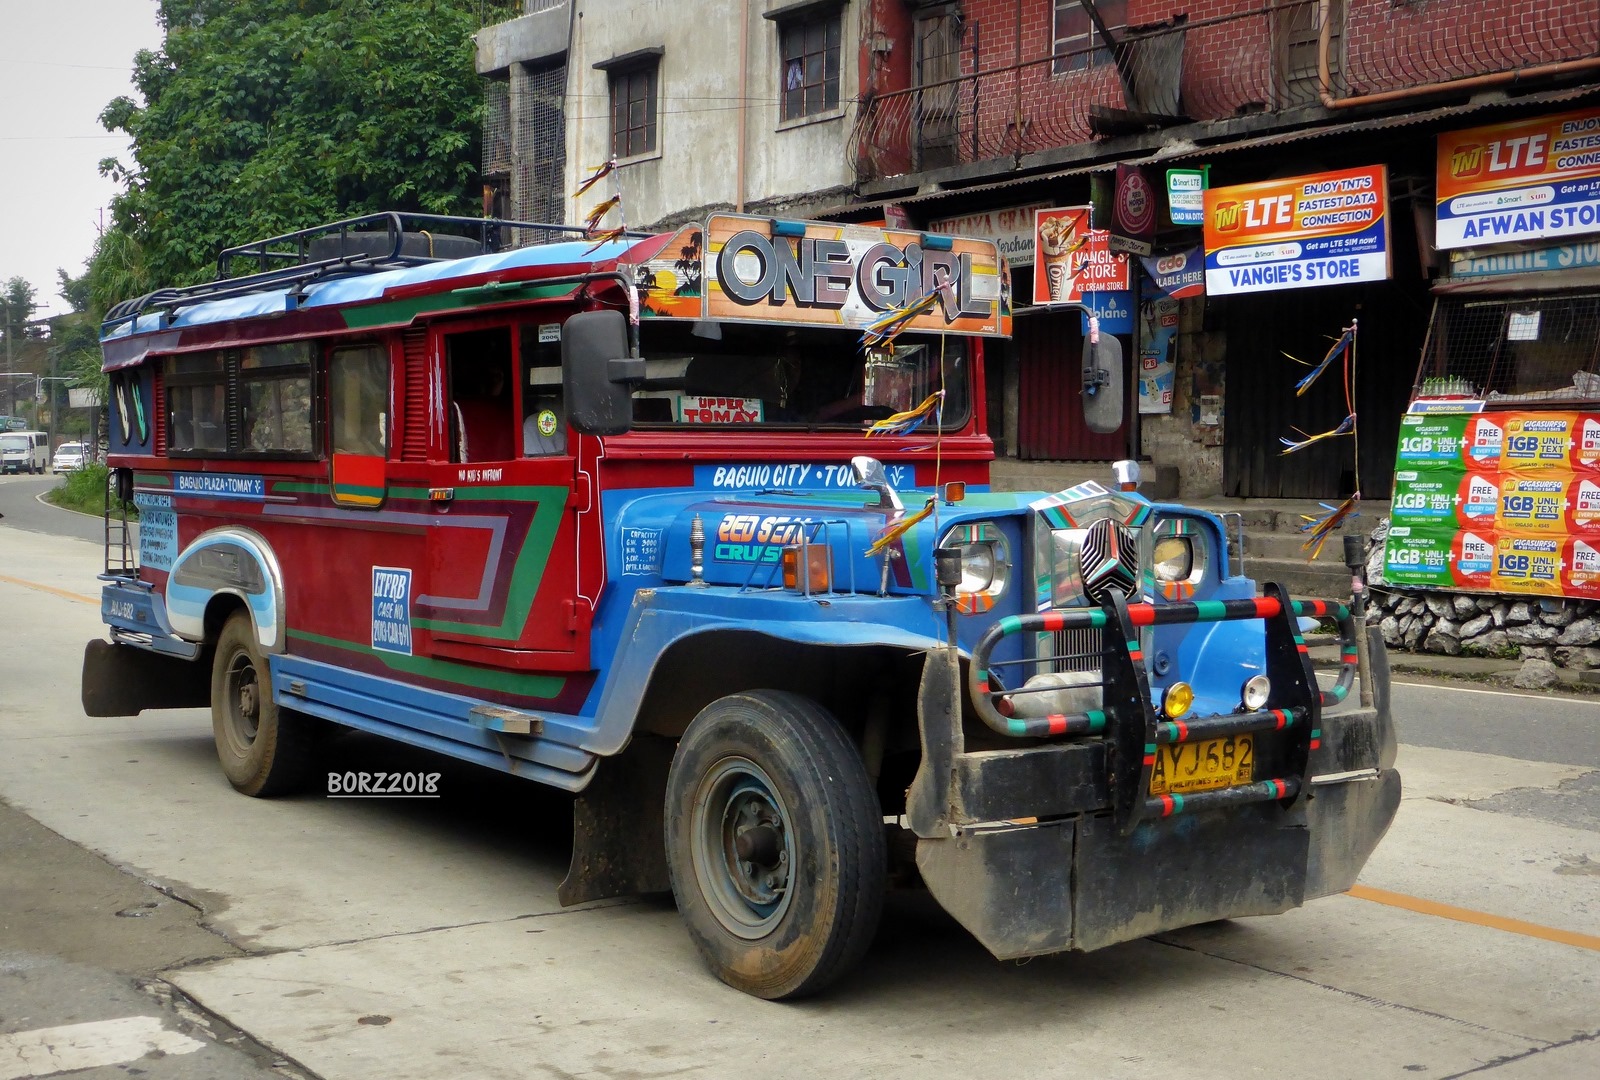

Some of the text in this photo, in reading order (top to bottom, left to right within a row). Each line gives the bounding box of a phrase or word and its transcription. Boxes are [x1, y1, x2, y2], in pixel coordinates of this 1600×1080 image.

[1562, 117, 1600, 133] ENJO
[1553, 136, 1600, 152] FASTES
[1488, 134, 1547, 172] LTE
[1452, 146, 1483, 175] TNT
[1190, 178, 1200, 186] LTE
[1304, 177, 1371, 195] ENJOY TNT'S
[1561, 185, 1576, 194] Get
[1128, 198, 1144, 206] HORSE
[1298, 193, 1376, 211] FASTEST DATA
[1504, 196, 1522, 204] Smart
[1171, 212, 1184, 220] LOAD
[1216, 202, 1241, 230] TNT
[1243, 195, 1293, 228] LTE
[1302, 209, 1371, 227] CONNECTION
[1463, 211, 1544, 239] AFWAN
[1330, 240, 1343, 248] LTE
[1344, 238, 1358, 246] SIM
[1359, 236, 1377, 244] now!
[1159, 256, 1184, 271] cdo
[1454, 243, 1600, 273] ANNIE STO
[719, 230, 854, 306] ONE
[1083, 263, 1117, 279] STORE
[1230, 259, 1360, 287] VANGIE'S STORE
[1182, 271, 1202, 283] HERE
[1076, 281, 1124, 292] ICE CREAM STORE
[1087, 306, 1127, 319] olane
[698, 397, 744, 412] UPPER
[684, 409, 758, 423] TOMAY
[1478, 428, 1498, 437] FREE
[1585, 430, 1600, 438] FRE
[1400, 437, 1432, 453] 1GB
[1437, 437, 1457, 445] UNLI
[1508, 436, 1538, 451] 1GB
[1542, 437, 1564, 445] UNLI
[1436, 445, 1457, 453] TEXT
[1541, 445, 1564, 453] TEXT
[713, 466, 770, 489] BAGUIO
[773, 464, 812, 487] CITY
[179, 476, 253, 493] BAGUIO PLAZA TOMAY
[1471, 486, 1492, 495] FREE
[1395, 493, 1426, 509] 1GB
[1431, 494, 1450, 502] UNLI
[1537, 497, 1558, 505] UNLI
[1580, 491, 1600, 499] FREE
[1430, 502, 1450, 510] TEXT
[1503, 496, 1534, 511] 1GB
[1536, 505, 1559, 513] TEXT
[630, 531, 658, 539] CAPACITY
[718, 514, 760, 543] RED
[715, 543, 784, 562] CRUIS
[1465, 543, 1485, 551] FREE
[1388, 549, 1420, 565] 1GB
[1425, 550, 1443, 558] UNLI
[1576, 552, 1595, 561] FREE
[1424, 558, 1444, 566] TEXT
[1498, 554, 1529, 570] 1GB
[1533, 557, 1554, 565] UNLI
[1531, 565, 1554, 573] TEXT
[374, 572, 407, 603] LTFRB
[377, 602, 405, 621] CASE NO.
[1169, 777, 1212, 789] PHILIPPINES
